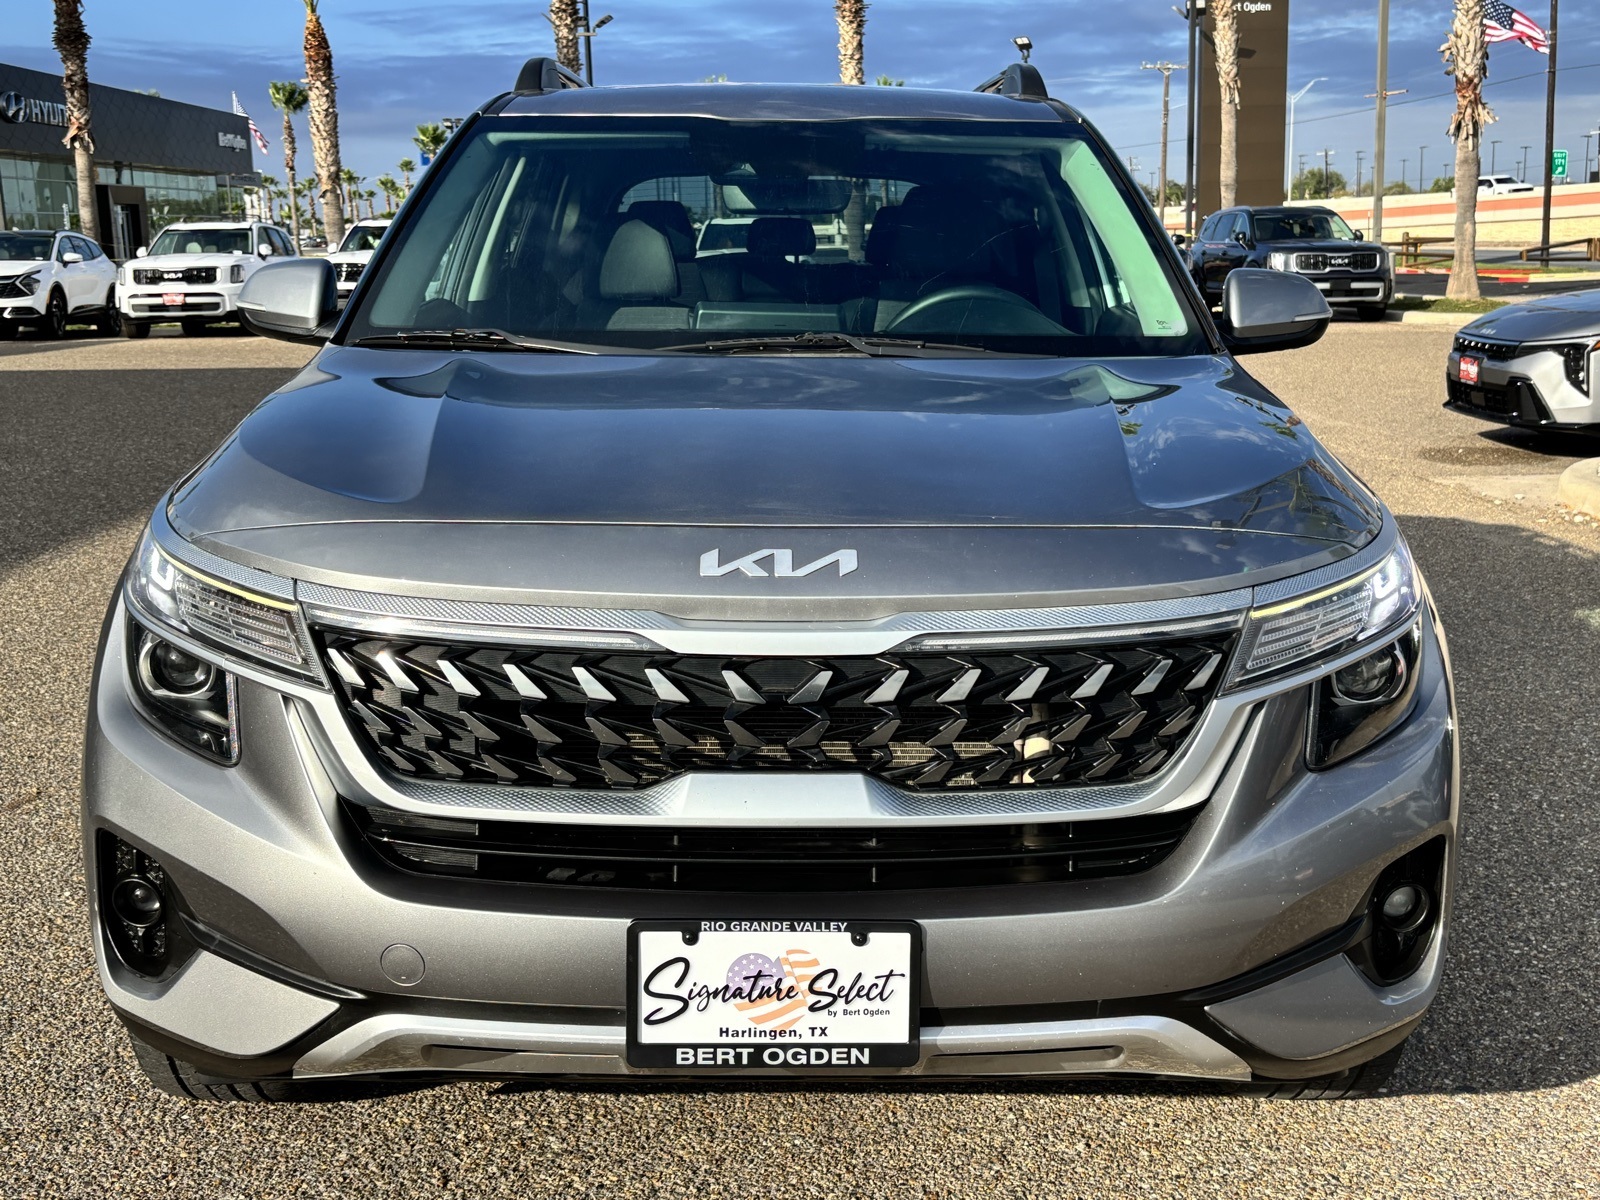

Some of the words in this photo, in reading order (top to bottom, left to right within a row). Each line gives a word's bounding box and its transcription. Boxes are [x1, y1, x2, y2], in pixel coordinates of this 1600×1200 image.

[1243, 2, 1272, 13] Ogden
[30, 98, 68, 127] HYUN
[1555, 158, 1565, 166] 171
[700, 548, 858, 577] KIA
[701, 921, 726, 932] RIO
[730, 921, 791, 932] GRANDE
[793, 922, 848, 932] VALLEY
[643, 957, 799, 1026] Signature
[807, 968, 906, 1013] Select
[827, 1009, 838, 1017] by
[843, 1008, 860, 1016] Bert
[863, 1008, 891, 1017] Ogden
[719, 1027, 803, 1041] Harlingen,
[808, 1027, 829, 1037] TX
[676, 1048, 755, 1065] BERT
[762, 1047, 870, 1065] OGDEN
